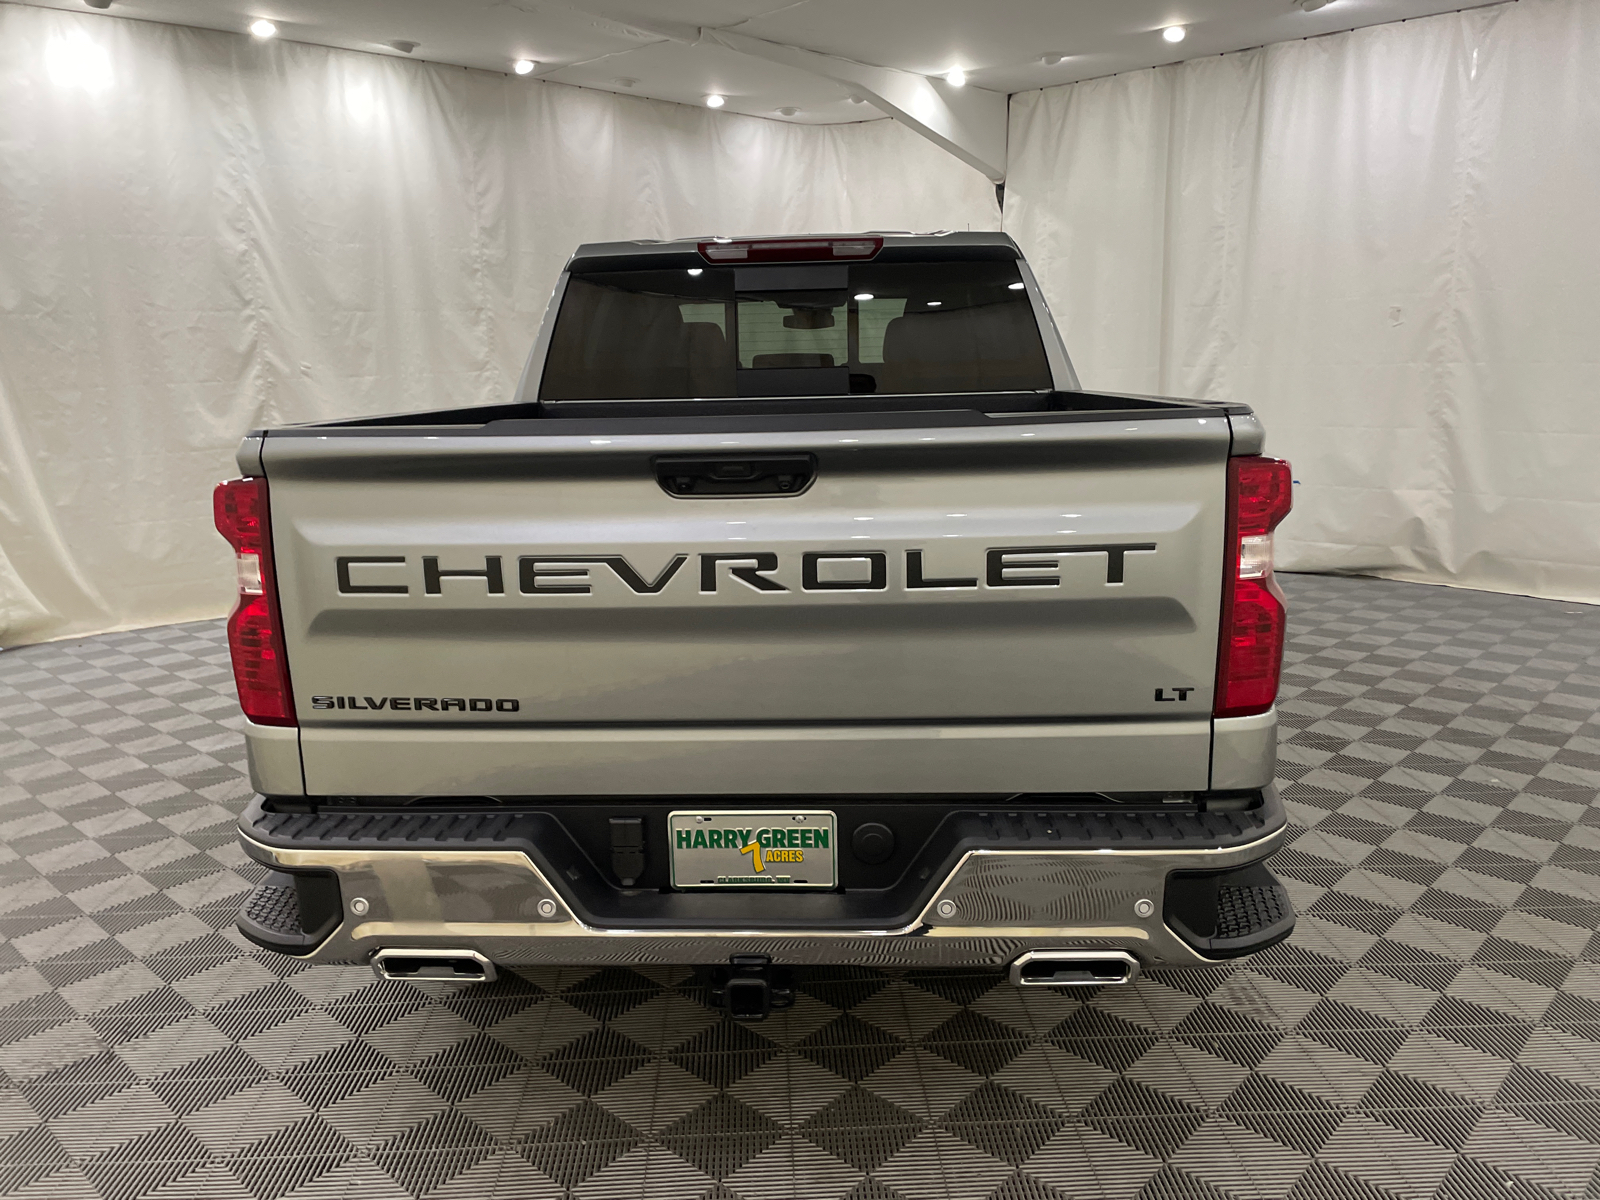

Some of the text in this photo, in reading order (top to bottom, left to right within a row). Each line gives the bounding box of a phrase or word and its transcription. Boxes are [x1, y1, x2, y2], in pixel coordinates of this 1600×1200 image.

[335, 543, 1157, 596] CHEVROLET
[311, 695, 520, 712] SILVERADO
[1154, 687, 1195, 702] LT
[675, 828, 830, 849] HARRY GREEN
[739, 840, 805, 874] 7 ACRES
